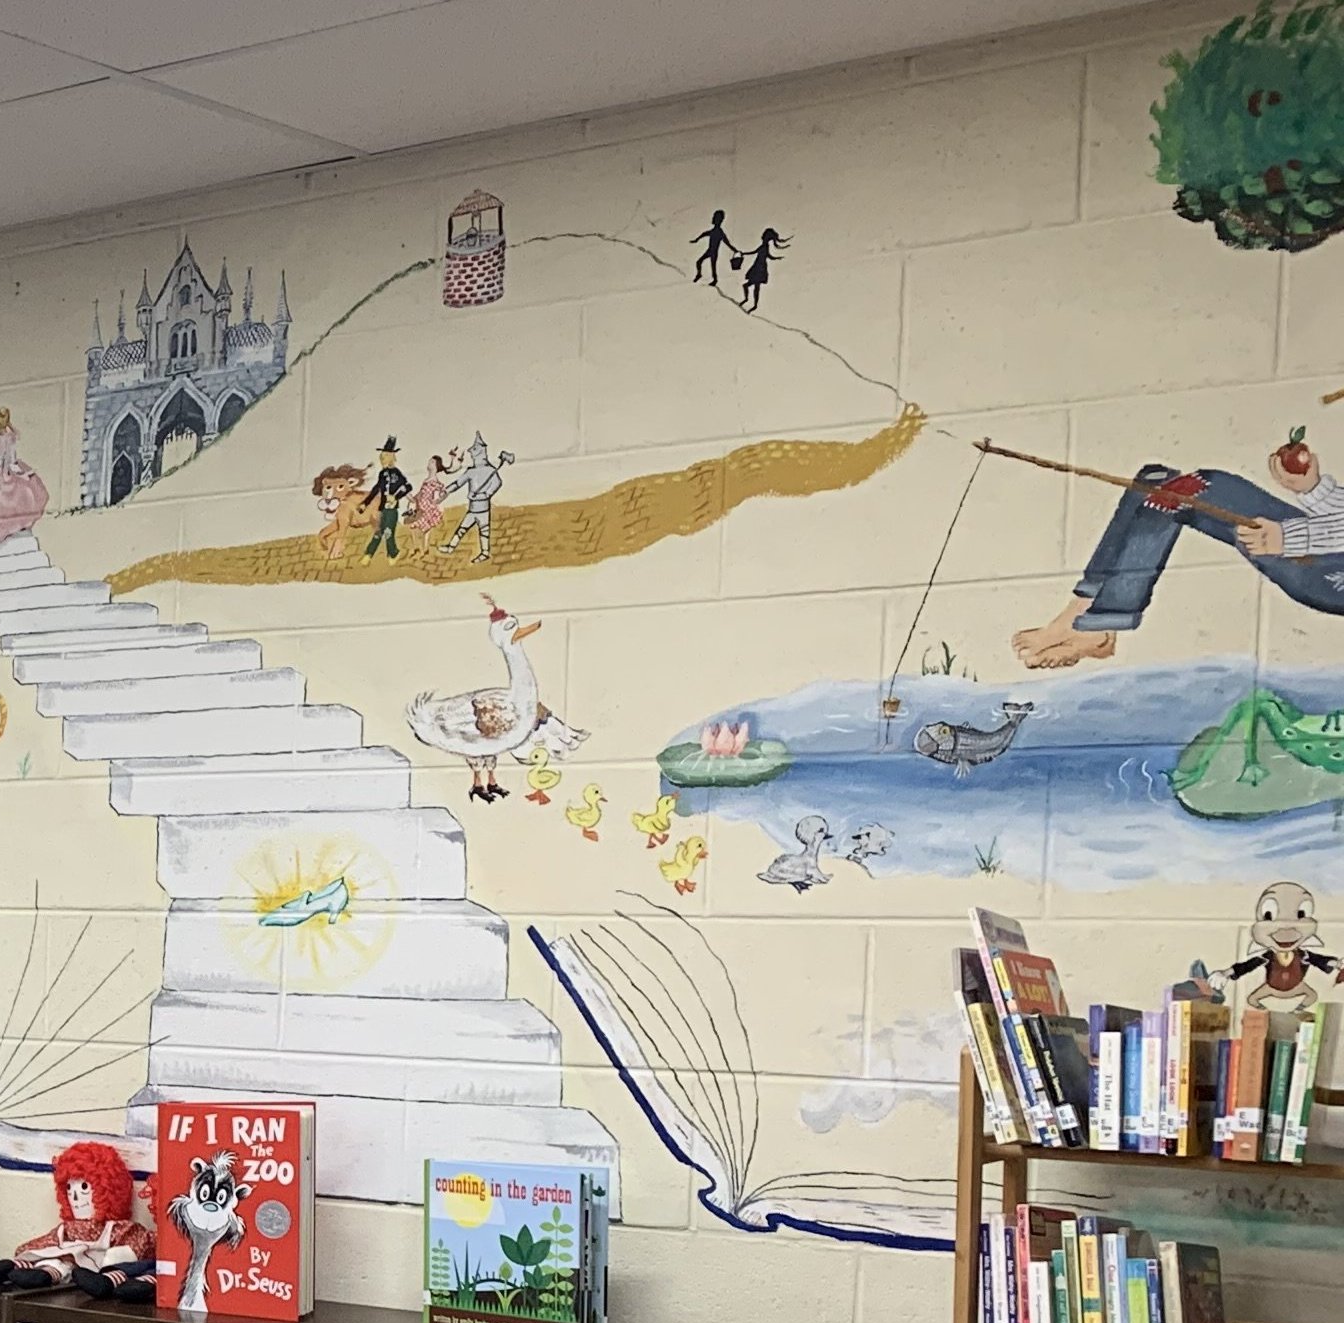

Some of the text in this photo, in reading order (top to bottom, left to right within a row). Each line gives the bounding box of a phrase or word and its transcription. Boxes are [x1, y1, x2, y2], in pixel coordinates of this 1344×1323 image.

[1103, 1074, 1112, 1090] The
[1103, 1093, 1112, 1111] Hat
[168, 1113, 286, 1147] IF I RAN
[250, 1144, 274, 1157] The
[241, 1159, 295, 1186] ZOO
[435, 1175, 572, 1206] counting in the garden
[249, 1246, 271, 1267] By
[216, 1267, 294, 1301] Dr. Seuss
